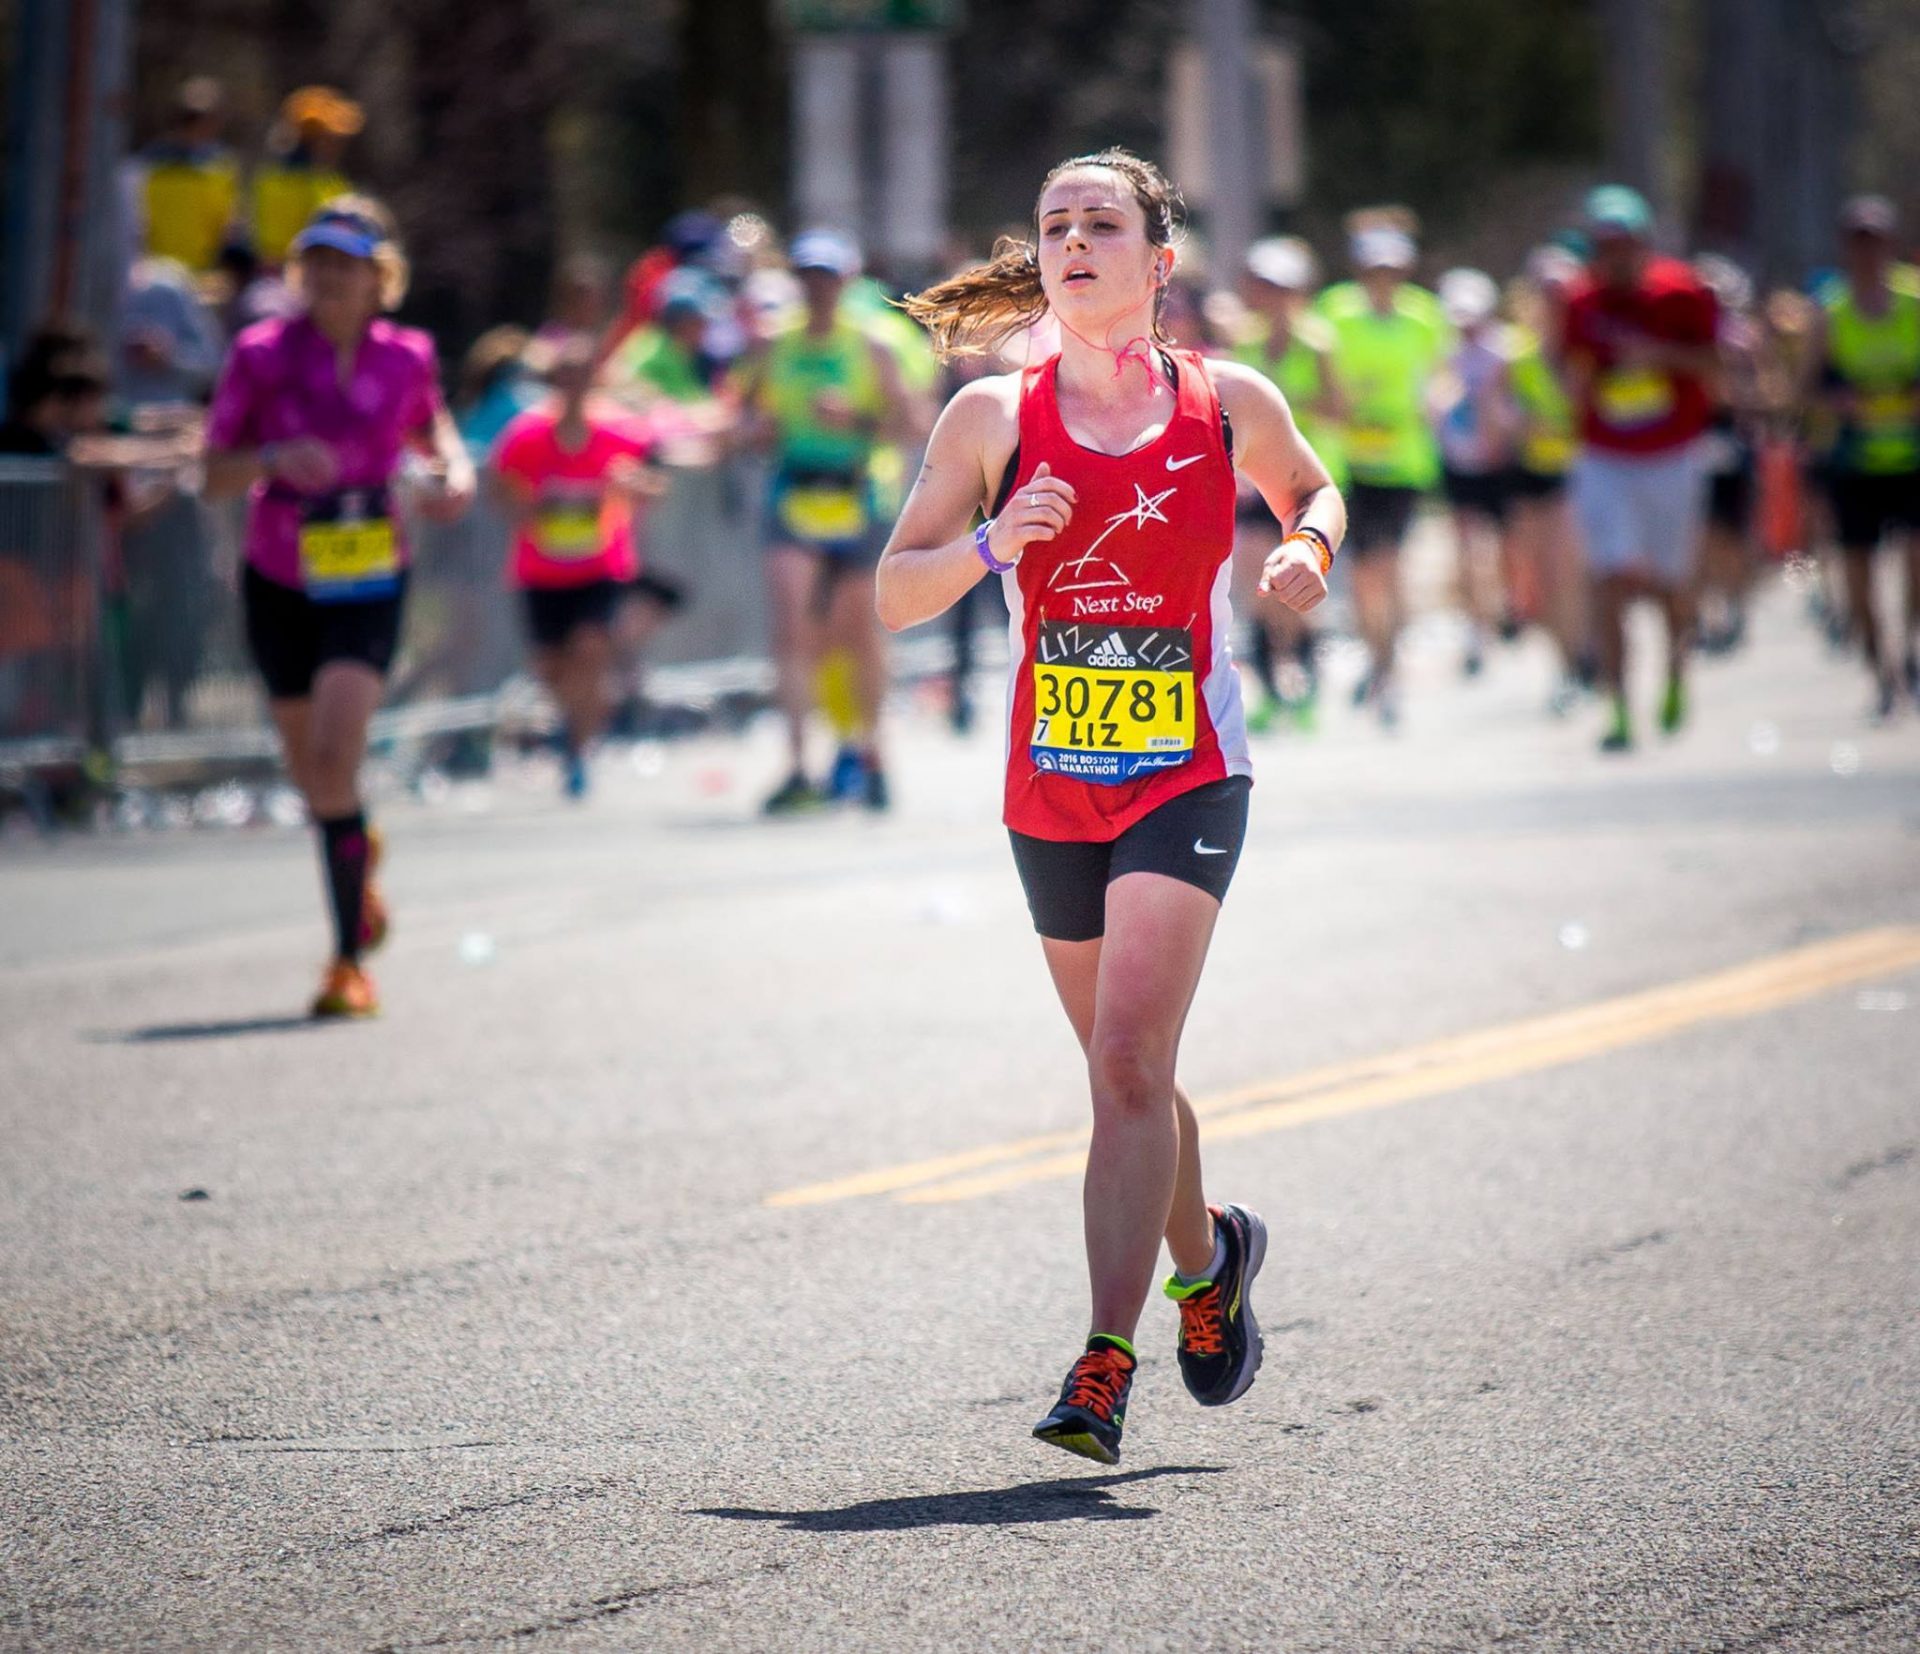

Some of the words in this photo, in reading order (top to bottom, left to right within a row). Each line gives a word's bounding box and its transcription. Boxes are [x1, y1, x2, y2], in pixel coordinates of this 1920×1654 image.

[1072, 595, 1119, 616] Next
[1123, 592, 1163, 614] Step
[1040, 625, 1094, 663] LIZ
[1087, 654, 1137, 668] adidas
[1041, 673, 1183, 723] 30781
[1037, 719, 1048, 741] 7
[1069, 721, 1123, 747] LIZ
[1058, 753, 1078, 763] 2016
[1080, 754, 1118, 764] BOSTON
[1059, 763, 1119, 775] MARATHON
